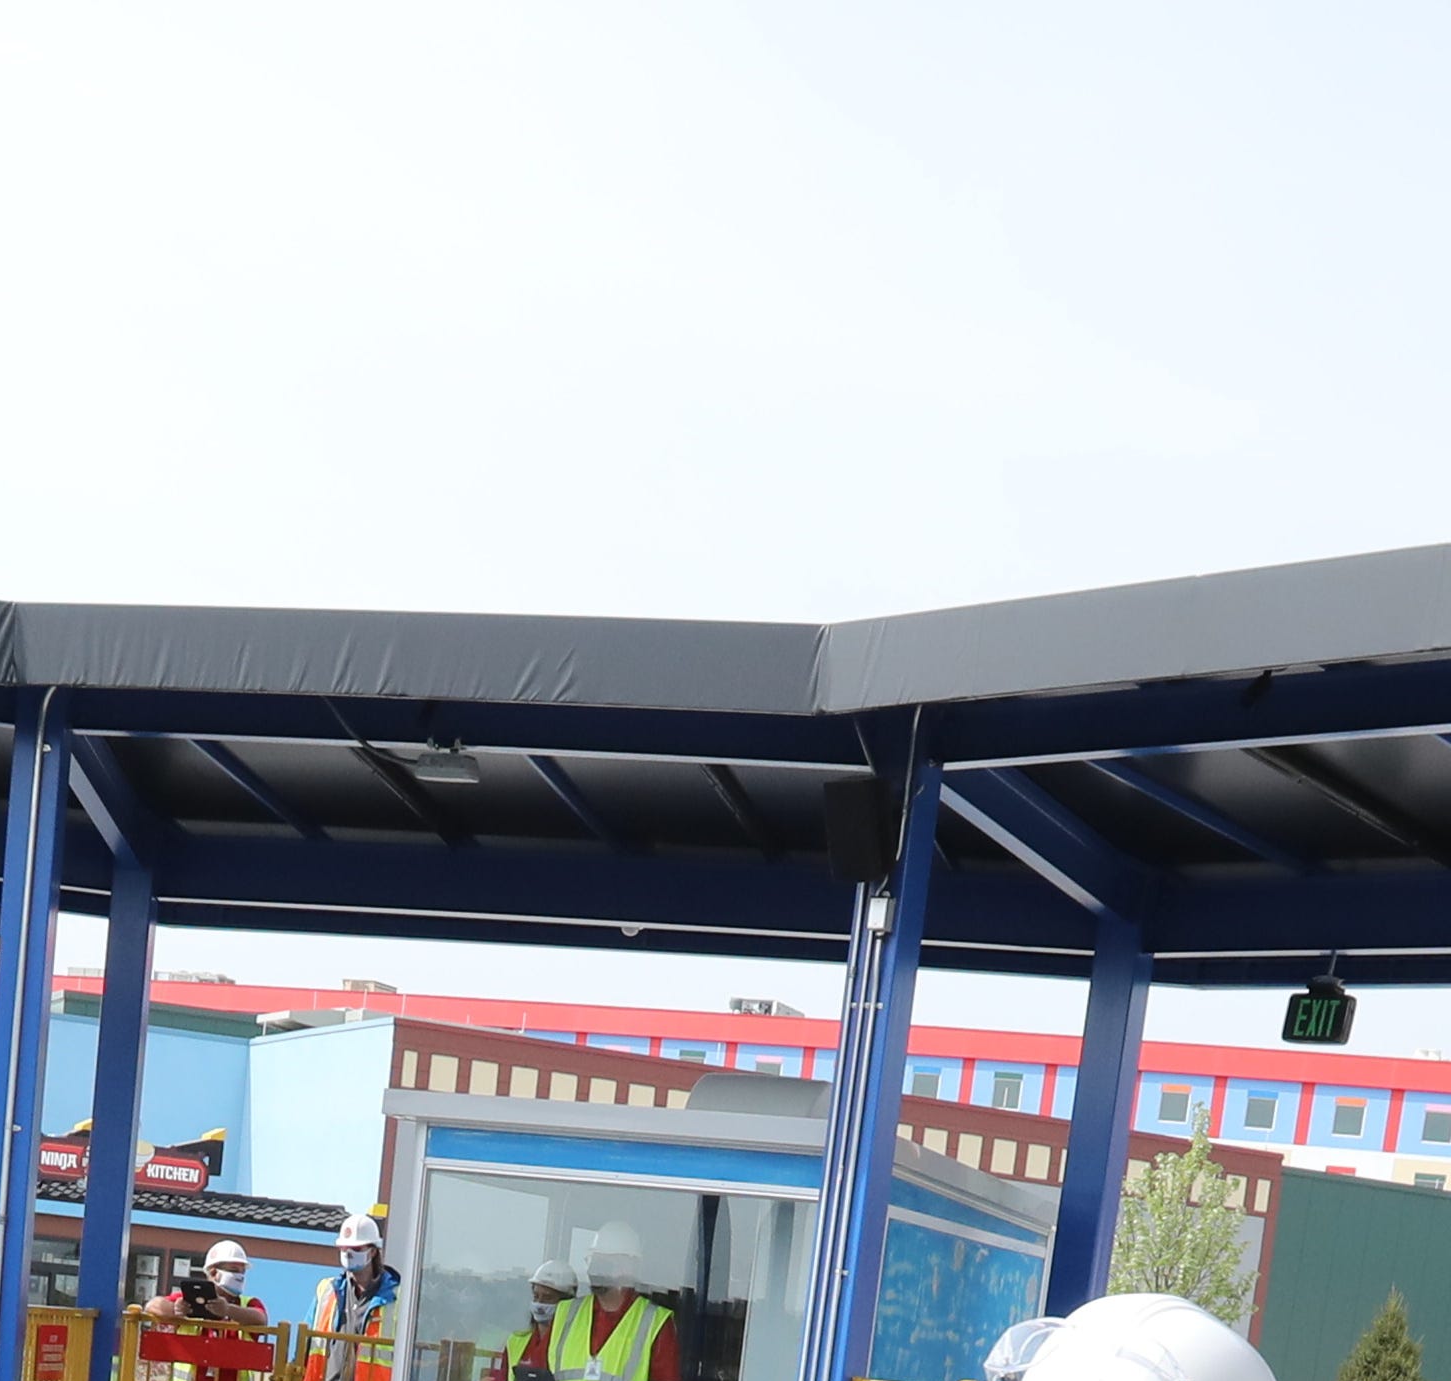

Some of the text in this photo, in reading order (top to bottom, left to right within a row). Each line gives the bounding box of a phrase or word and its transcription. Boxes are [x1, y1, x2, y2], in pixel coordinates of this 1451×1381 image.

[1293, 999, 1341, 1037] EXIT
[40, 1150, 200, 1183] NINJA KITCHEN
